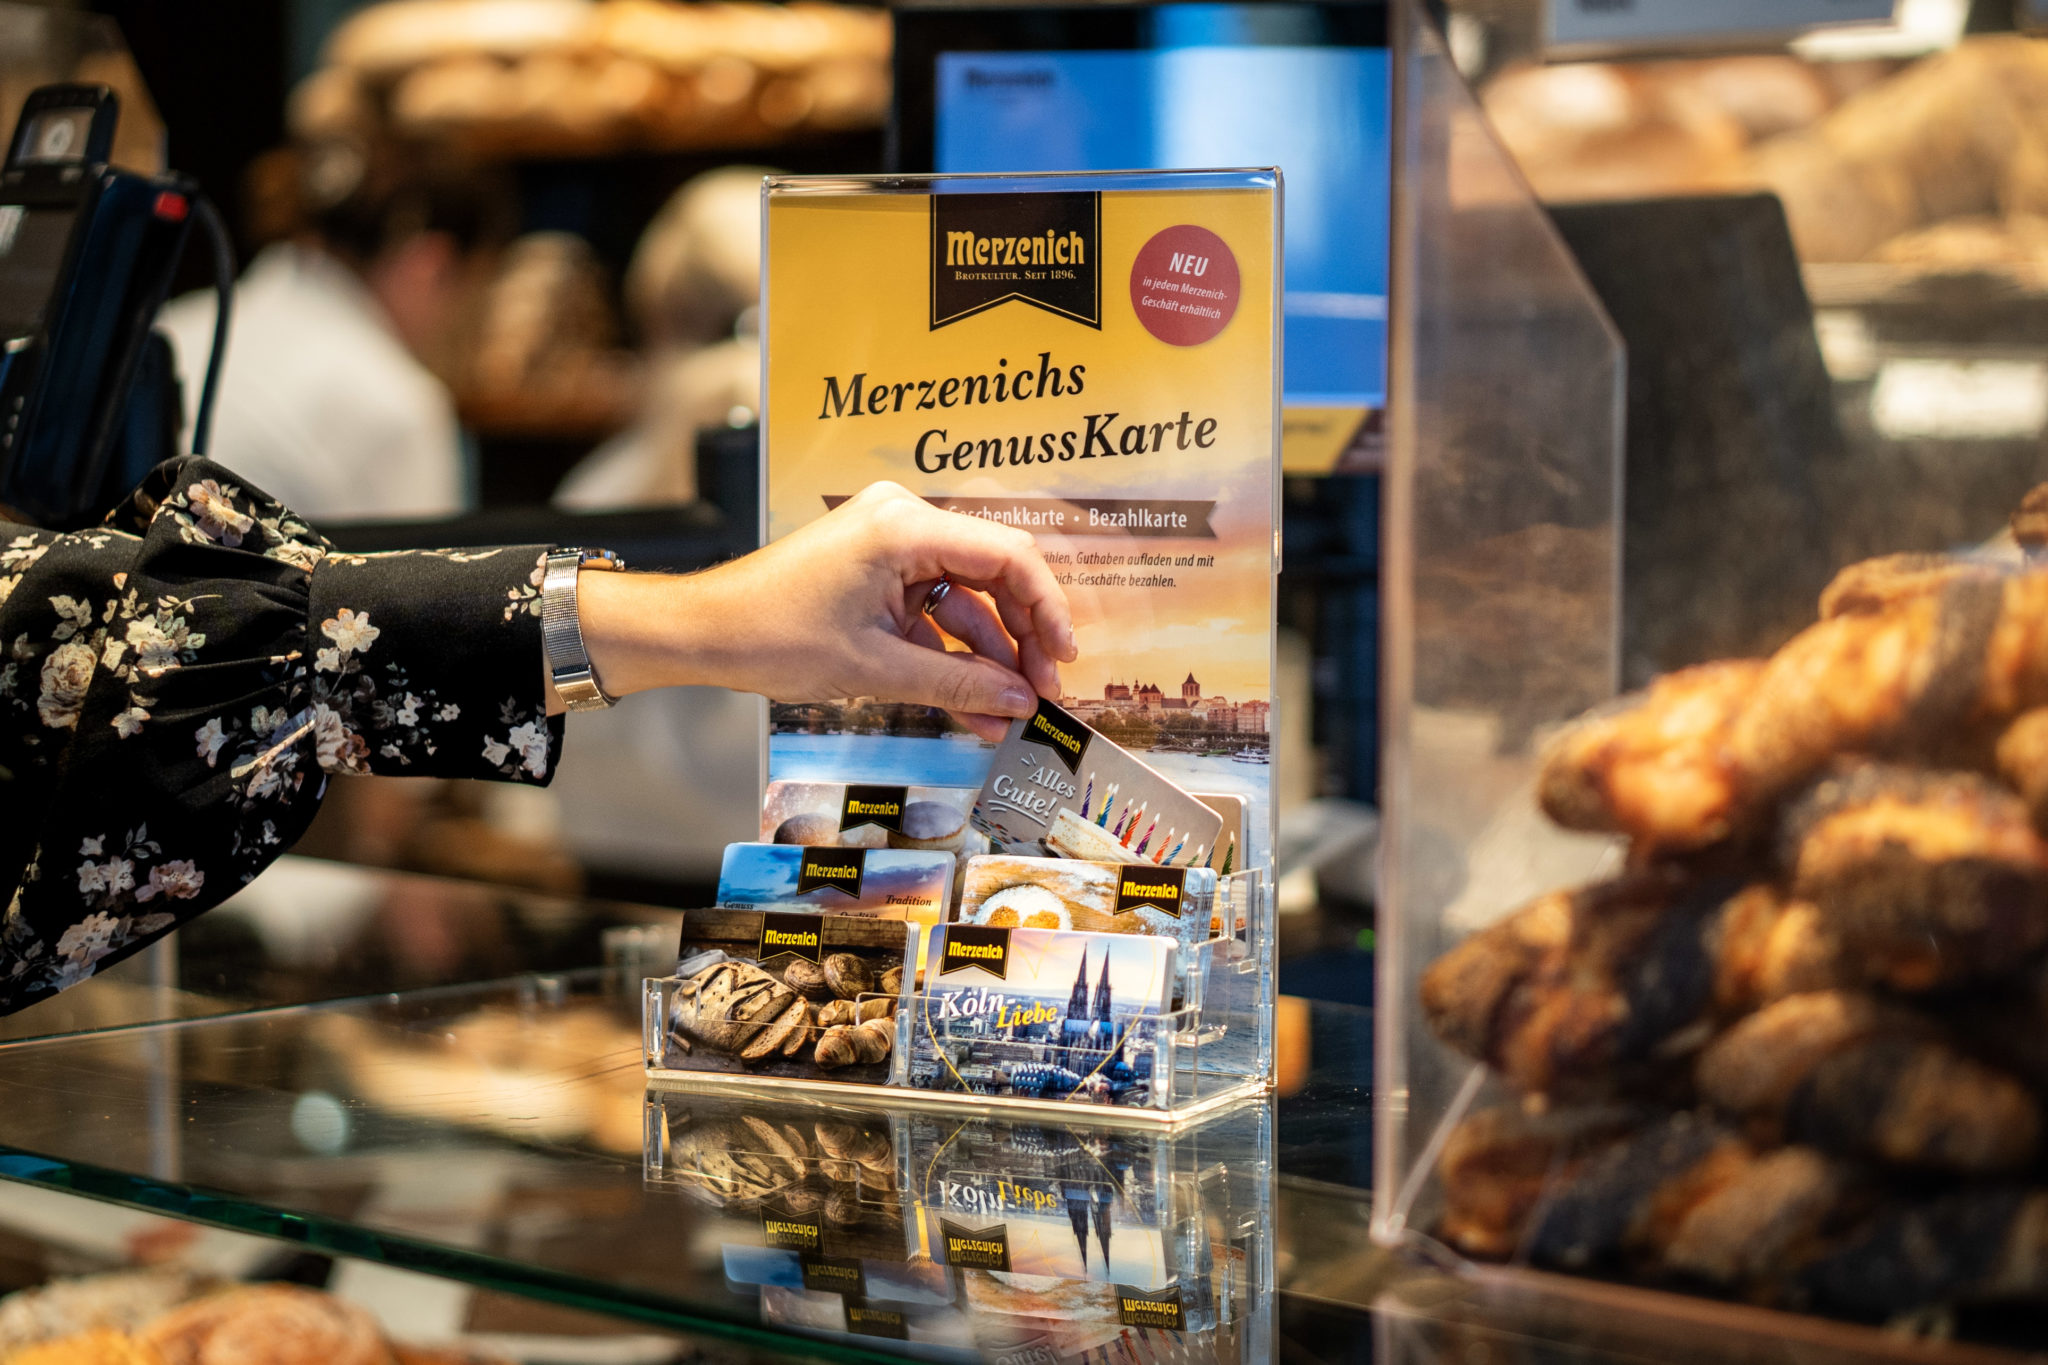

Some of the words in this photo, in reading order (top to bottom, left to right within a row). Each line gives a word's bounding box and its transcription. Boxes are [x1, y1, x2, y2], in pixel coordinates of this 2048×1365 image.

[946, 229, 1085, 266] Merzenich
[1050, 269, 1077, 280] 1896.
[1168, 252, 1209, 277] NEU
[1142, 276, 1152, 287] in
[1151, 278, 1180, 292] jedem
[1180, 282, 1228, 301] Merzenich-
[1141, 295, 1179, 312] Geschäft
[1179, 303, 1221, 320] erhältlich
[818, 352, 1086, 420] Merzenichs
[914, 411, 1218, 474] GenussKarte
[1089, 508, 1188, 528] Bezahlkarte
[1043, 551, 1073, 566] ählen,
[1076, 551, 1125, 565] Guthaben
[1127, 552, 1172, 567] aufladen
[1174, 553, 1195, 567] und
[1196, 554, 1215, 568] mit
[1055, 572, 1126, 587] ich-Geschäfte
[1128, 573, 1177, 588] bezahlen.
[1033, 713, 1082, 754] Merzenich
[1028, 766, 1076, 798] Alles
[847, 800, 900, 816] Merzenich
[993, 775, 1058, 818] Gute!
[806, 863, 858, 880] Merzenich
[885, 894, 932, 907] Tradition
[1122, 881, 1178, 899] Merzenich
[764, 930, 818, 947] Merzenich
[948, 941, 1003, 960] Merzenich
[937, 986, 1016, 1019] Köln-
[996, 1001, 1058, 1029] Liebe
